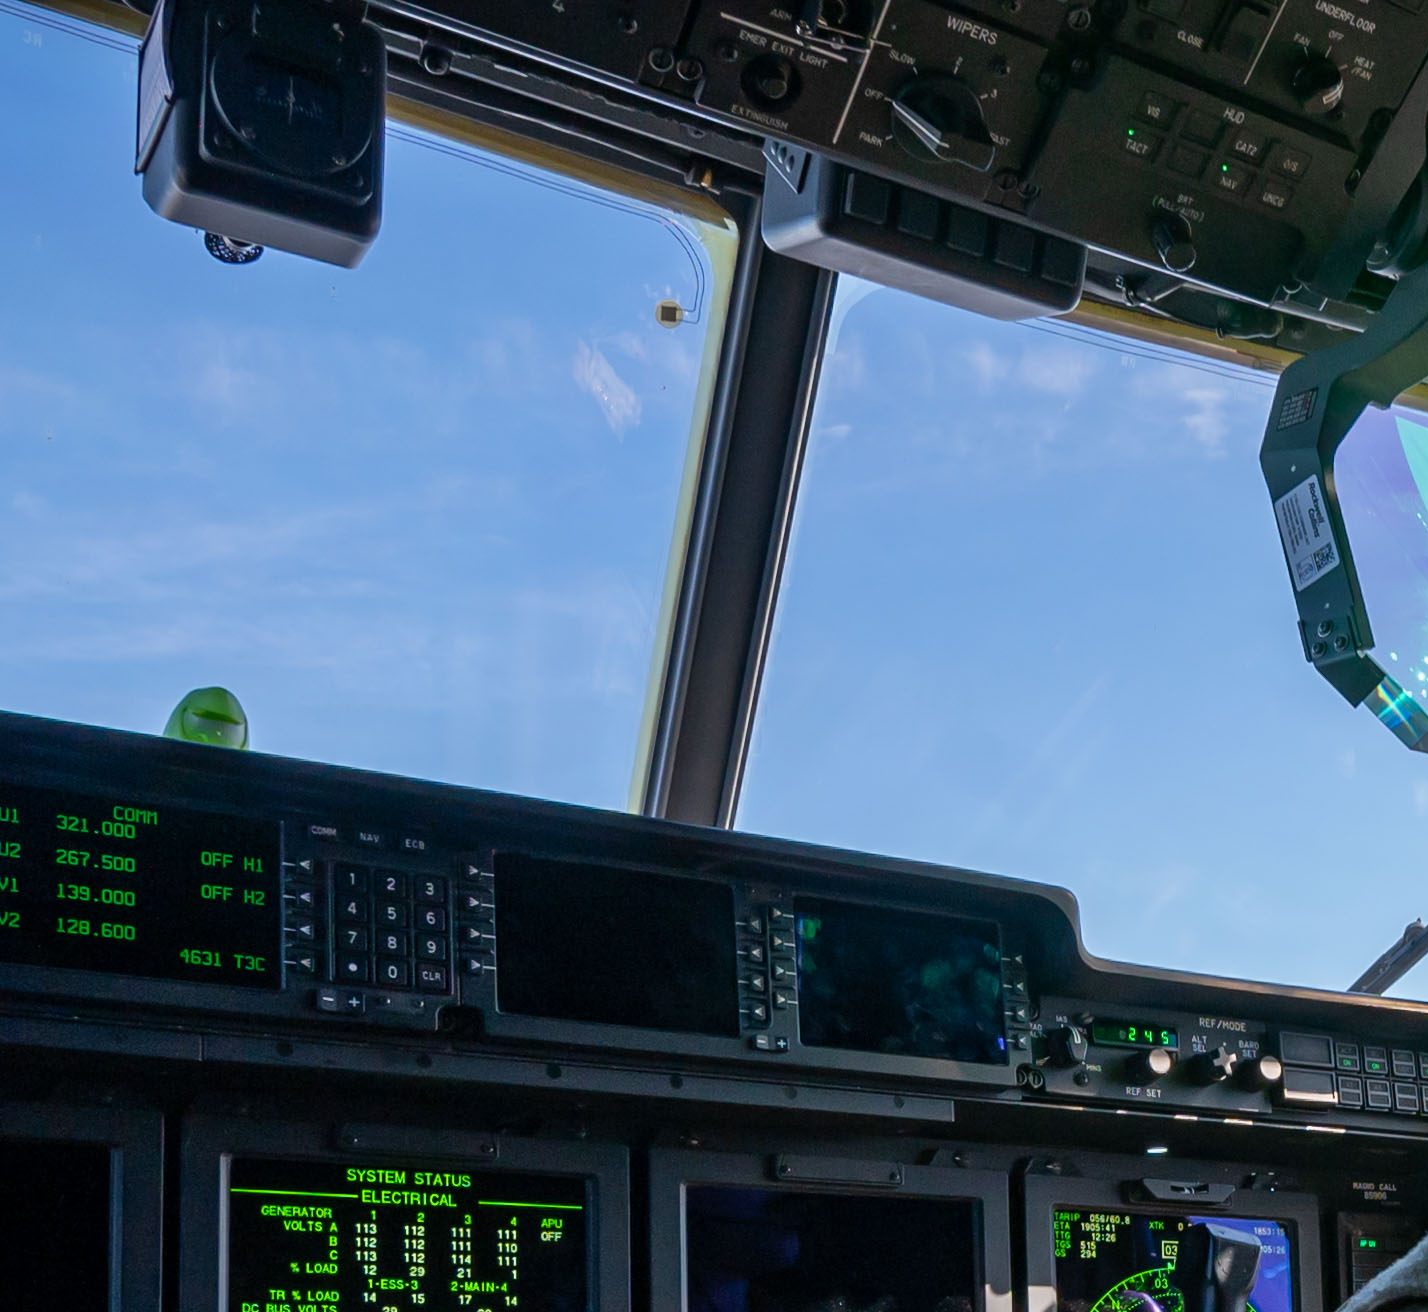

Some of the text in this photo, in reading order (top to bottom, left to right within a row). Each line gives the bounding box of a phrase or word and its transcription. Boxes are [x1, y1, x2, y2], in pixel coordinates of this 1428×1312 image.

[1315, 0, 1376, 34] UNDERFLOOR
[946, 15, 998, 45] WIPERS
[1328, 29, 1345, 42] OFF
[1177, 30, 1204, 49] CLOSE
[1293, 33, 1310, 47] FAN
[739, 29, 828, 69] EMER EXIT LIGHT
[888, 49, 916, 66] SLOW
[1354, 55, 1375, 70] HEAT
[864, 88, 884, 100] OFF
[731, 104, 789, 130] EXTINGUISH
[1147, 104, 1161, 119] VIS
[1223, 107, 1245, 125] HUD
[858, 131, 884, 147] PARK
[1125, 138, 1149, 155] TACT
[1235, 140, 1257, 156] CAT2
[1308, 482, 1324, 523] Rockwell
[1308, 508, 1320, 538] Collins
[113, 806, 158, 826] COMM
[57, 812, 135, 838] 321.000
[311, 825, 337, 837] COMM
[359, 832, 380, 844] NAV
[56, 849, 135, 872] 267.500
[201, 852, 233, 867] OFF
[244, 857, 262, 872] H1
[57, 884, 135, 906] 139.000
[201, 885, 232, 900] OFF
[244, 890, 264, 905] H2
[57, 918, 135, 940] 128.600
[180, 949, 264, 971] 4631 T3C
[423, 970, 441, 982] CLR
[1199, 1016, 1247, 1032] REF/MODE
[1191, 1034, 1208, 1044] ALT
[1125, 1086, 1161, 1098] REF SET
[347, 1169, 471, 1187] SYSTEM STATUS
[362, 1189, 457, 1207] ELECTRICAL
[261, 1205, 562, 1228] GENERATOR APU
[1054, 1211, 1080, 1222] TARIP
[284, 1221, 562, 1241] VOLTS 113 112 111 111 OFF
[1053, 1221, 1116, 1232] ETA 1905:41
[1148, 1221, 1165, 1230] XTK
[1055, 1231, 1117, 1242] TTG 12:26
[1055, 1240, 1071, 1249] TGS
[356, 1237, 517, 1253] 112 112 111 110
[1054, 1248, 1067, 1257] GS
[356, 1251, 516, 1266] 113 112 114 111
[306, 1263, 471, 1278] LOAD 12 29 21
[368, 1279, 507, 1292] 1-ESS-3 2-MAIN-4
[1154, 1278, 1168, 1289] 03
[270, 1290, 517, 1306] TR LOAD 14 15 17 14
